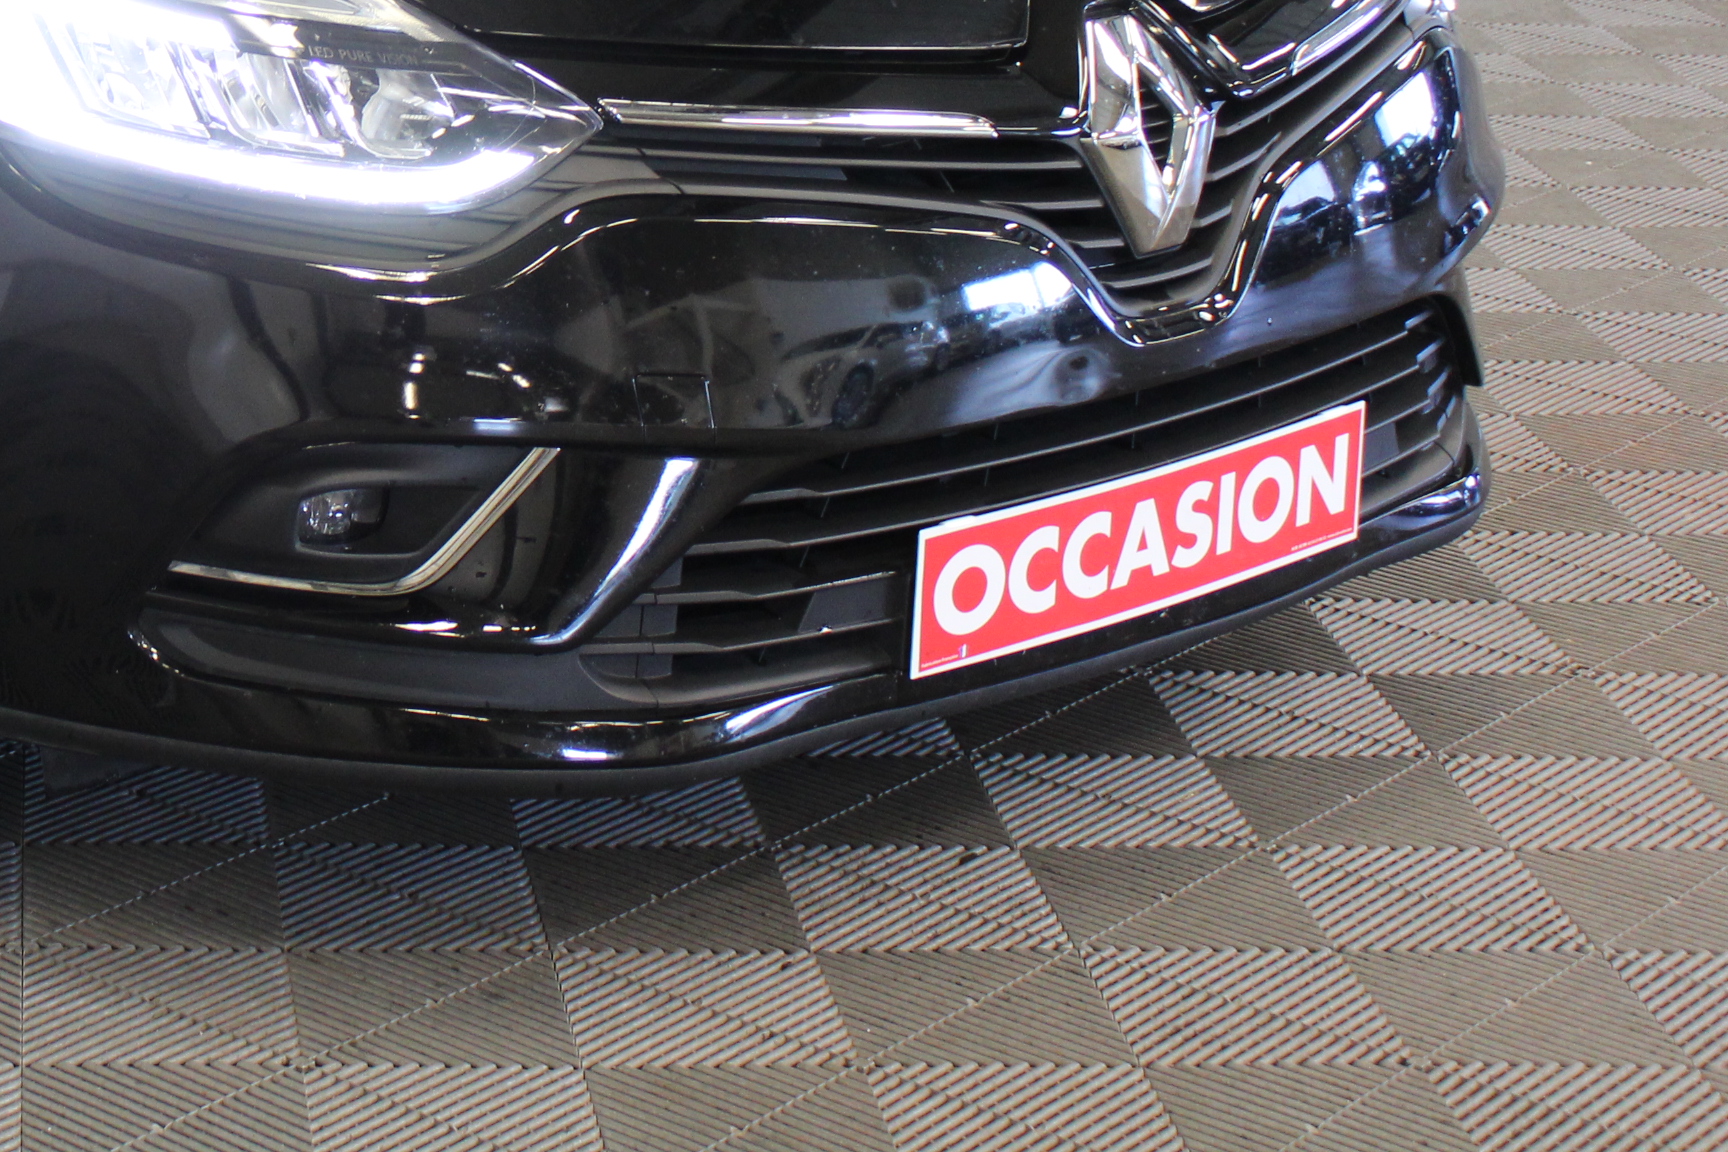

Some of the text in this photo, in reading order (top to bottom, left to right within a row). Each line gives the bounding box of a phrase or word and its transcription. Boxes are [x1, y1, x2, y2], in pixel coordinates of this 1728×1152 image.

[308, 45, 418, 65] LED PURE VISION
[933, 433, 1349, 635] OCCASION
